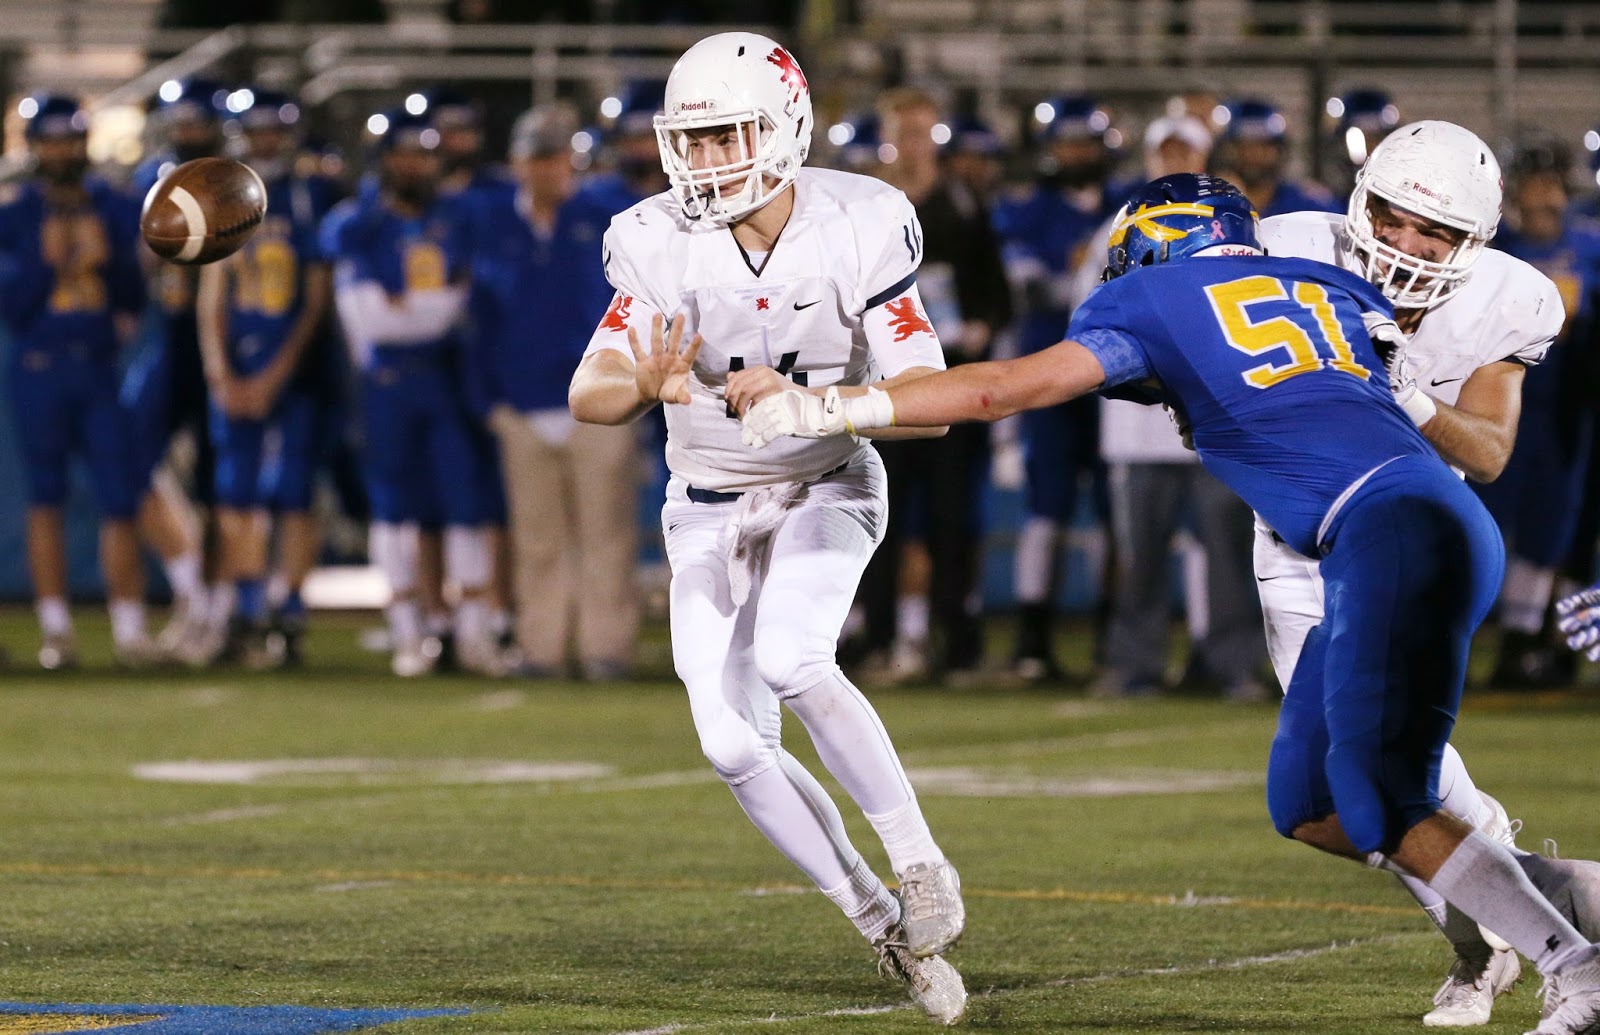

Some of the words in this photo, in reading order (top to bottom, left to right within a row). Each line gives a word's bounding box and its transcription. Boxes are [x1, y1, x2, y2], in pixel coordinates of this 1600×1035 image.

[681, 100, 707, 110] Riddell
[1412, 182, 1442, 201] Riddell
[1203, 275, 1371, 389] 51
